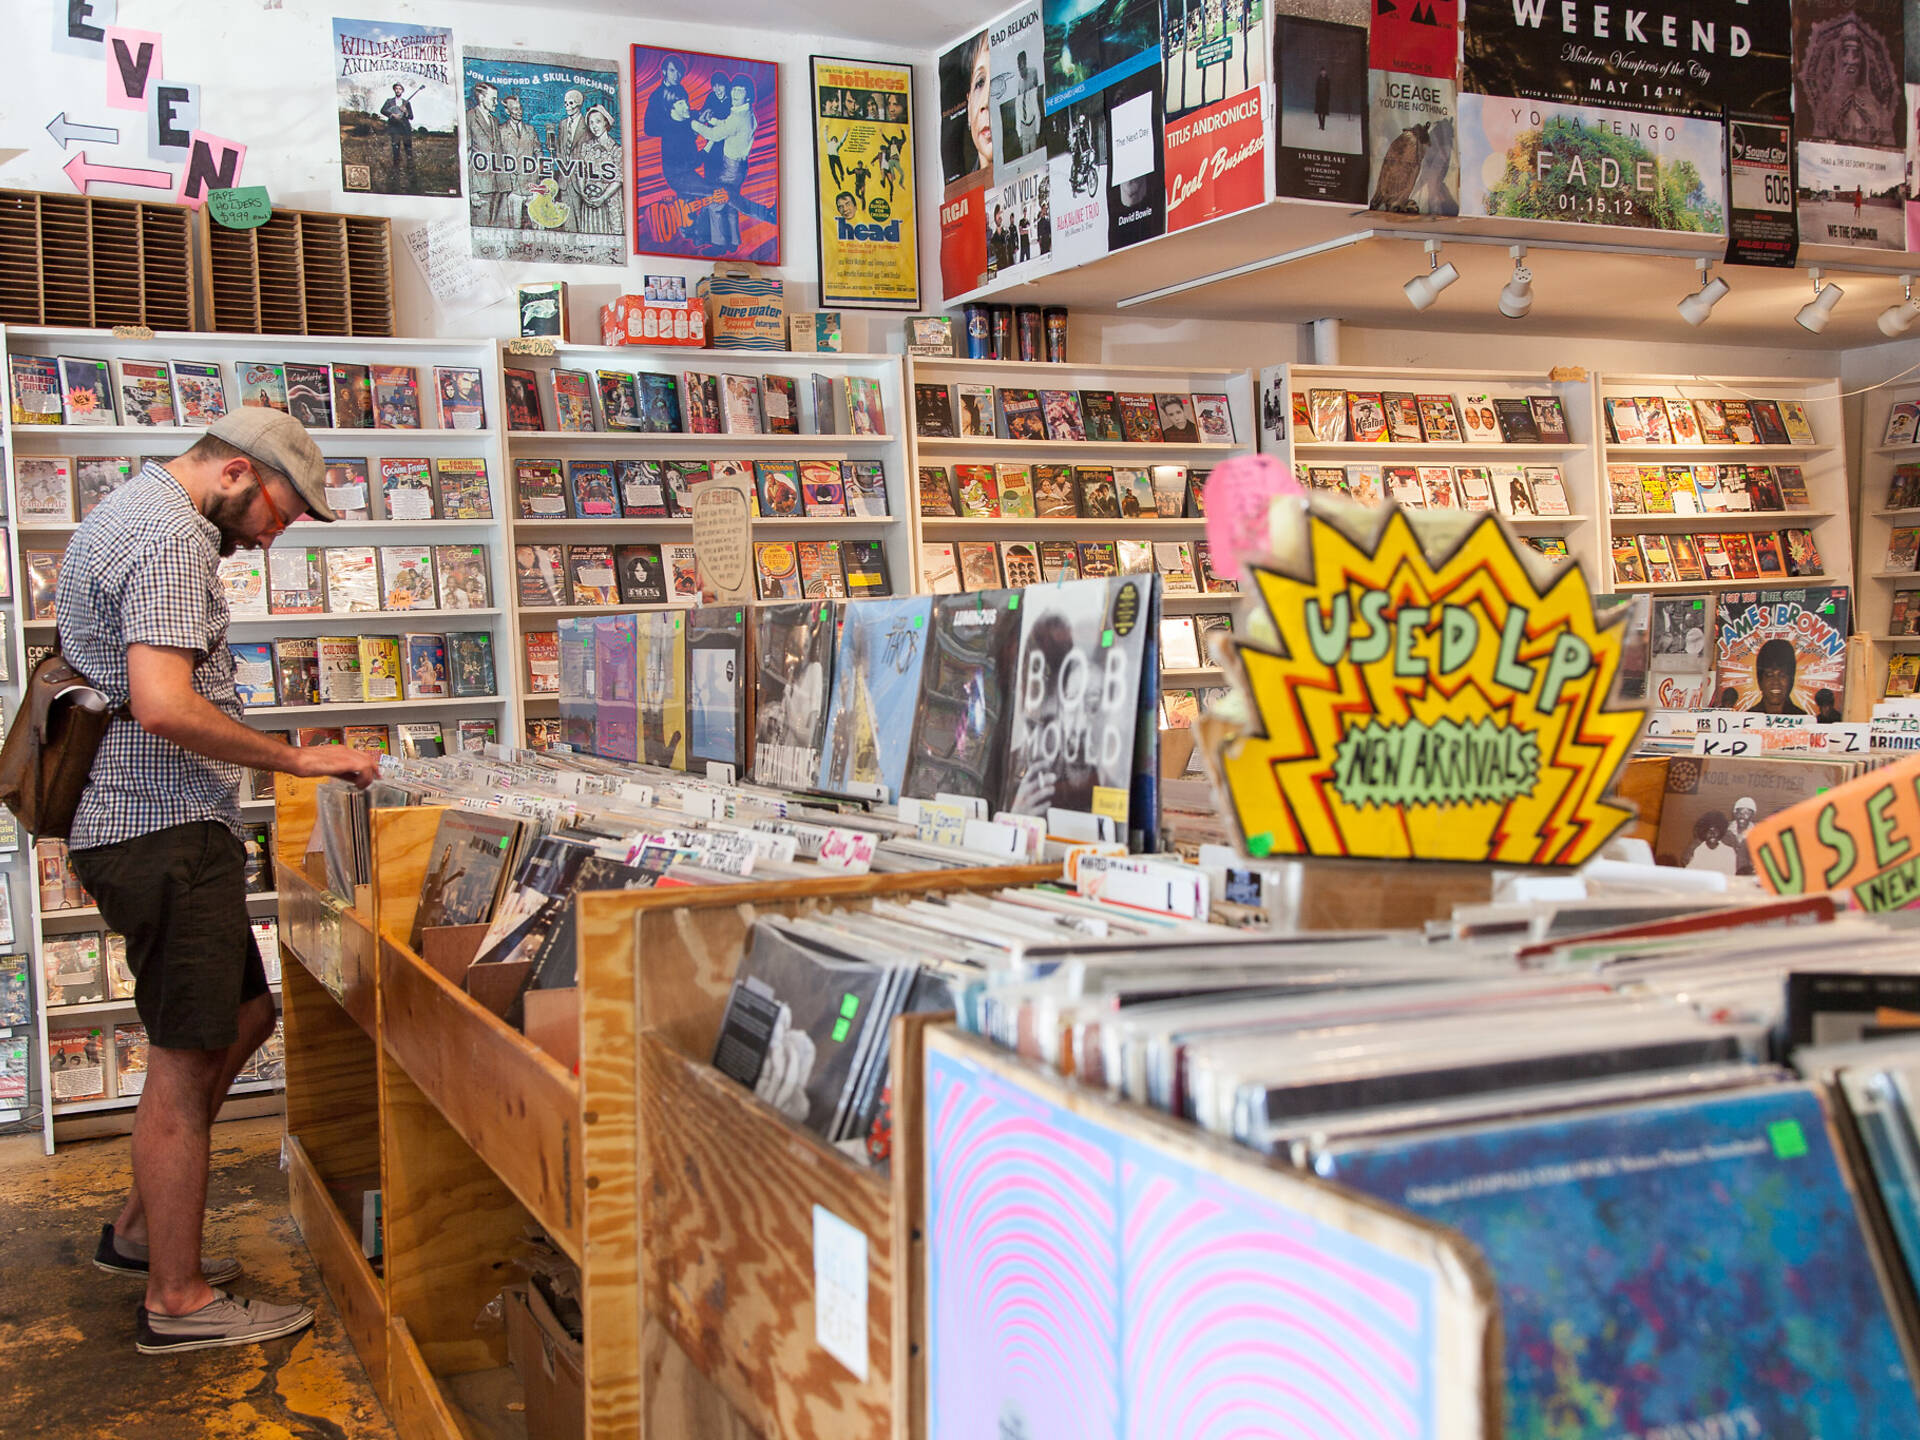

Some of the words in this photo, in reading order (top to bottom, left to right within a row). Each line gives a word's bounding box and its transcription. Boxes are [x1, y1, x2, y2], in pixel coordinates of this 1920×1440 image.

[991, 30, 1006, 46] BAD
[1007, 10, 1039, 37] RELIGION
[1512, 0, 1751, 58] WEEKEND
[340, 34, 399, 56] WILLIAM
[342, 58, 398, 76] ANIMALS
[418, 63, 449, 84] DARK
[1560, 43, 1606, 66] Modern
[1609, 50, 1658, 76] Vampires
[1659, 60, 1671, 78] of
[1671, 60, 1684, 74] the
[1687, 59, 1711, 85] City
[466, 69, 484, 81] JON
[486, 75, 530, 85] LANGFORD
[532, 75, 541, 84] &
[542, 73, 572, 83] SKULL
[573, 75, 616, 95] ORCHARD
[828, 72, 905, 90] monkees
[1386, 83, 1440, 103] ICEAGE
[1590, 78, 1628, 94] MAY
[1642, 85, 1682, 98] 14TH
[1380, 99, 1409, 110] YOU'RE
[1412, 102, 1448, 115] NOTHING
[1167, 125, 1190, 149] TITUS
[1192, 97, 1259, 139] ANDRONICUS
[1511, 109, 1541, 126] YO
[1557, 116, 1581, 132] LA
[1598, 119, 1676, 141] TENGO
[472, 152, 517, 173] OLD
[522, 156, 618, 181] DEVILS
[1324, 155, 1346, 163] BLAKE
[1745, 145, 1770, 158] Sound
[1770, 148, 1787, 163] City
[1168, 158, 1208, 211] Local
[1536, 151, 1655, 192] FADE
[208, 191, 237, 202] TAPE
[1004, 183, 1017, 210] SON
[1020, 175, 1038, 202] VOLT
[1765, 174, 1790, 205] 606
[216, 198, 262, 210] HOLDERS
[942, 198, 969, 225] RCA
[1085, 202, 1100, 220] TRIO
[1118, 211, 1135, 226] David
[1135, 206, 1153, 220] Bowie
[1559, 194, 1633, 216] 01.15.12
[835, 216, 903, 242] head
[1828, 224, 1838, 237] WE
[1839, 225, 1850, 238] THE
[1851, 226, 1878, 240] COMMON
[719, 305, 747, 318] pure
[748, 305, 782, 318] water
[17, 374, 55, 385] CHAINED
[23, 383, 49, 391] GIRLS
[1356, 417, 1385, 434] Keaton
[1726, 592, 1740, 603] GOT
[1717, 604, 1770, 660] JAMES
[1775, 602, 1846, 658] BROWN
[1304, 588, 1479, 678] USED
[1493, 603, 1591, 716] LP
[1024, 649, 1128, 710] BOB
[1697, 718, 1711, 729] YES
[1019, 724, 1122, 767] MOULD
[1348, 731, 1402, 789] NEW
[1409, 731, 1537, 789] ARRIVALS
[1702, 771, 1730, 786] KOOL
[1749, 773, 1805, 792] TOGETHER
[1759, 773, 1920, 896] USE
[1870, 869, 1919, 912] NEW
